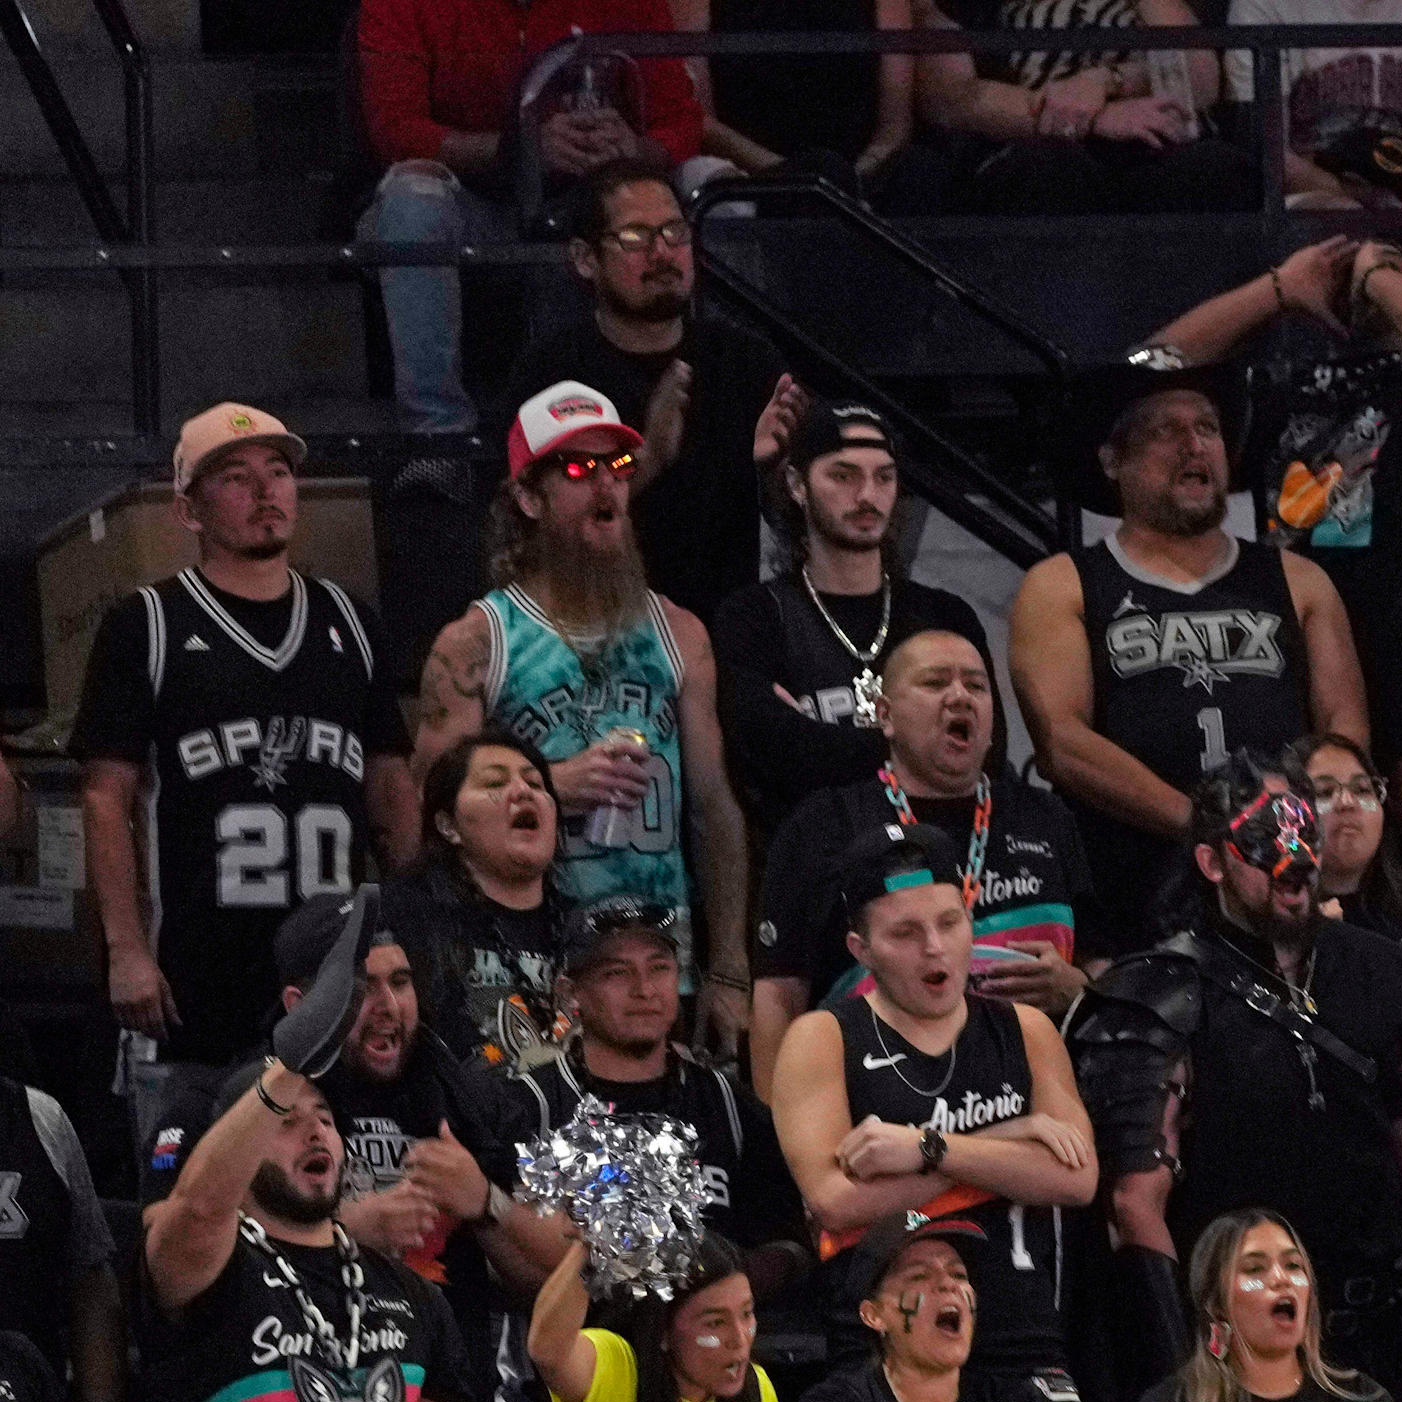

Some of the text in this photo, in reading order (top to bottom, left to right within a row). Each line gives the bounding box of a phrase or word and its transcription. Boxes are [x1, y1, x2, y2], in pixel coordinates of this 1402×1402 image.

[1107, 610, 1286, 676] SATX
[177, 716, 364, 792] SPURS
[1196, 706, 1226, 769] 1
[215, 802, 354, 908] 20
[931, 1082, 1025, 1136] Antonio
[1007, 1205, 1036, 1270] 1
[252, 1314, 313, 1366] San
